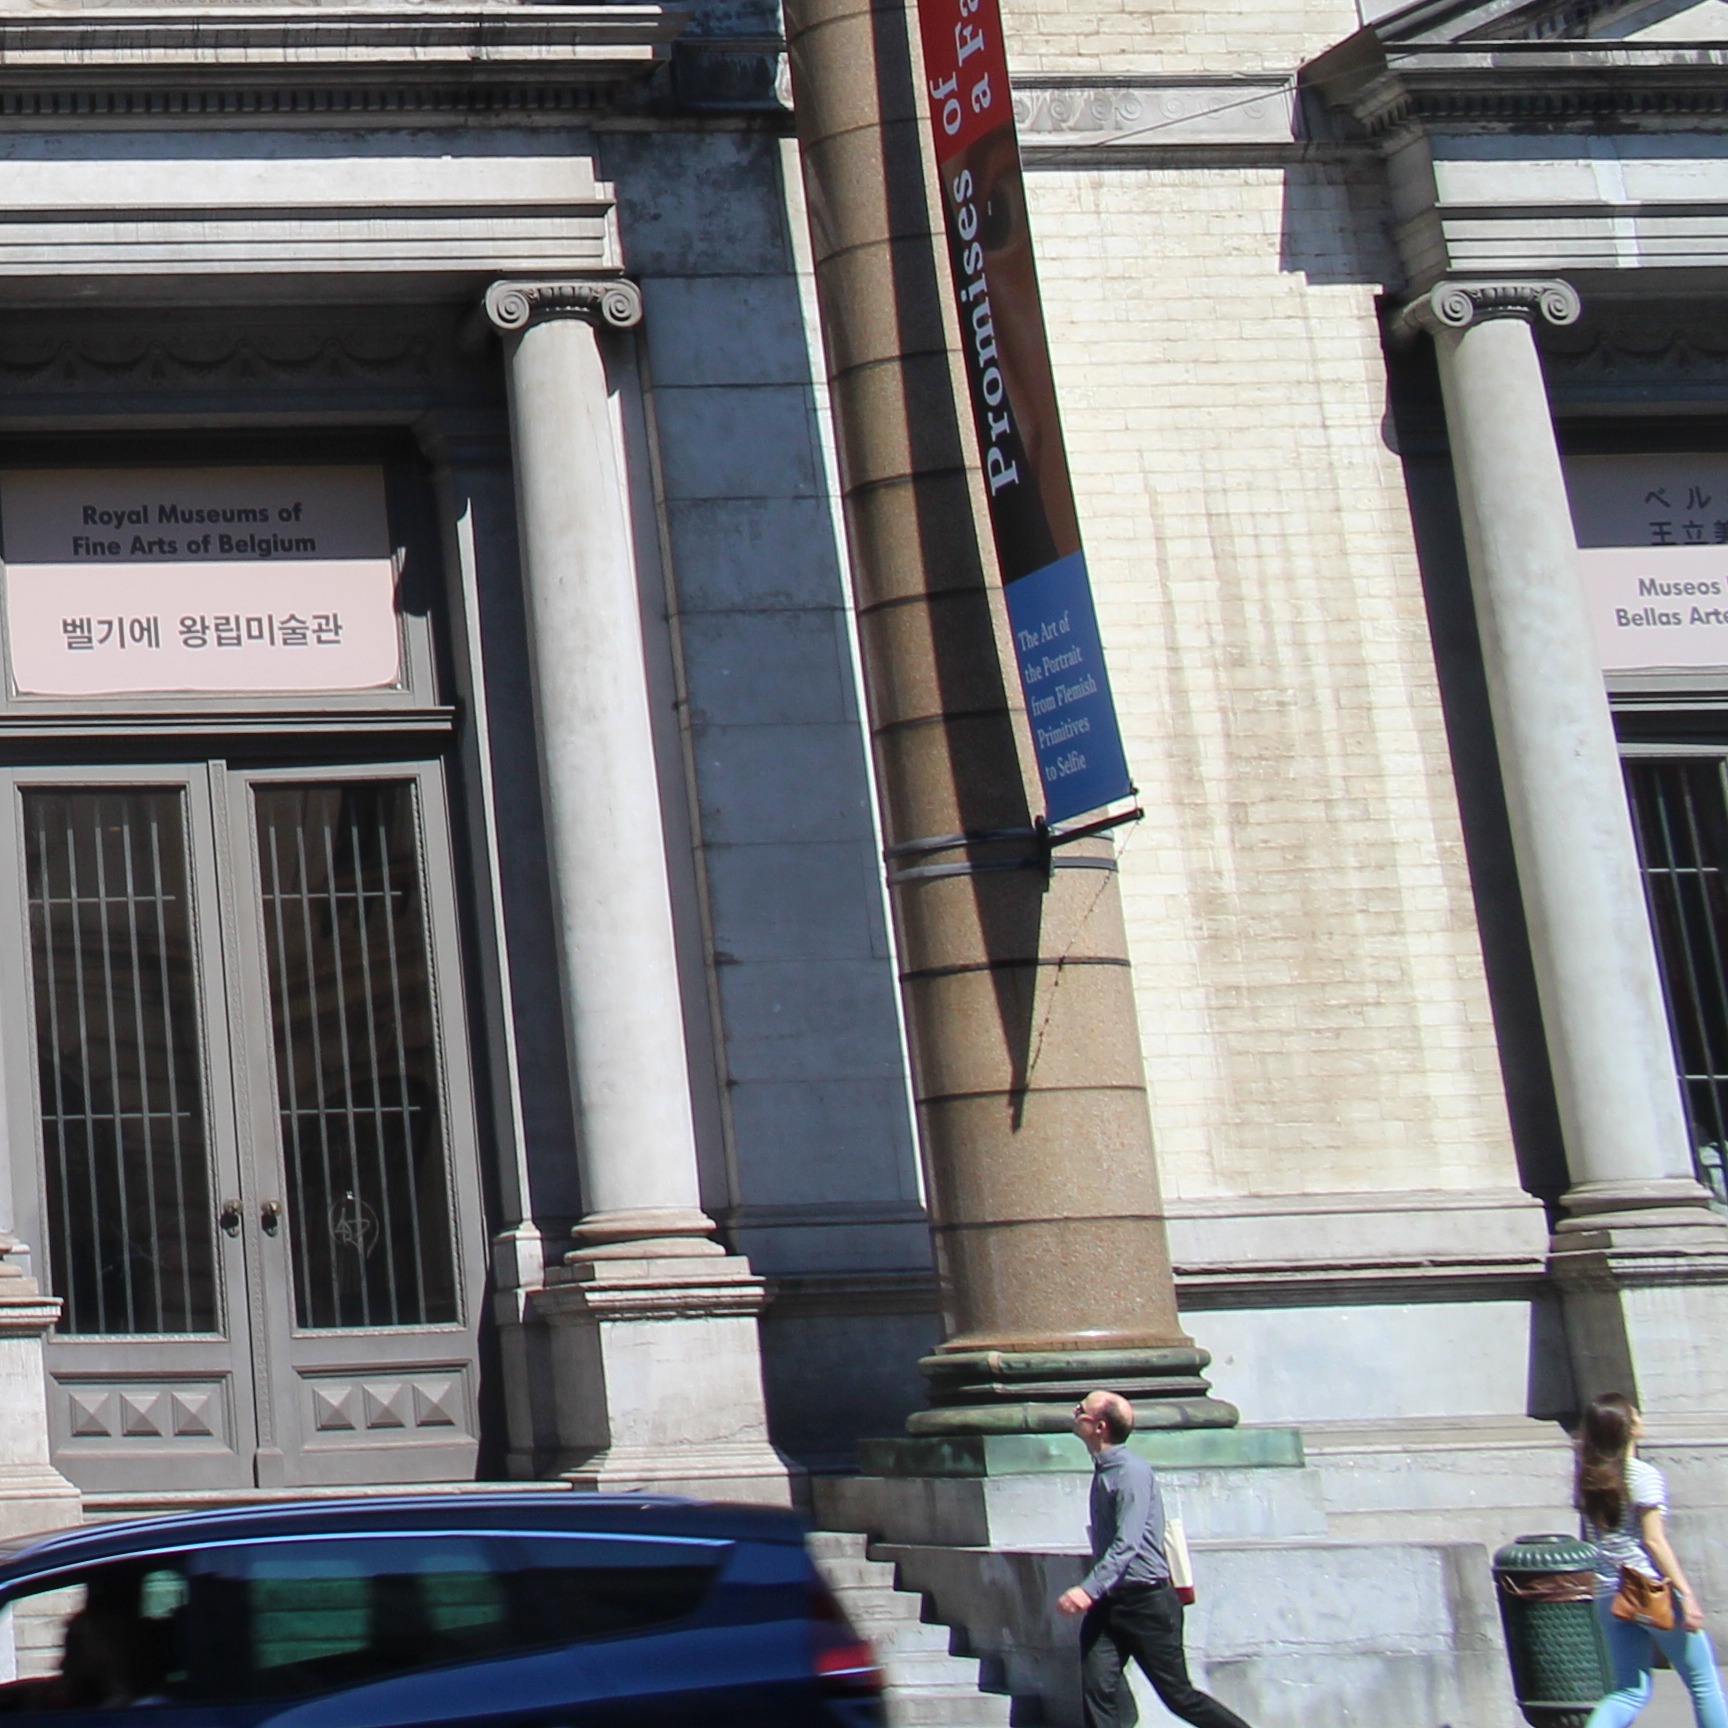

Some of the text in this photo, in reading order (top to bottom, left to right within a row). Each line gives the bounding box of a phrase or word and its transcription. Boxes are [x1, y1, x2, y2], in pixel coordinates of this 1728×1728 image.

[970, 77, 992, 114] a
[929, 70, 1019, 496] Promises of
[82, 502, 302, 530] Royal Museums of
[73, 532, 316, 558] Fine Arts of Belgium
[1638, 577, 1722, 597] Museos
[62, 613, 344, 651] 벨기에 왕립미술관
[1018, 610, 1071, 652] The Art of
[1615, 607, 1682, 627] Bellas
[1025, 645, 1084, 684] the Portrait
[1031, 673, 1098, 716] from Flemish
[1037, 716, 1090, 749] Primitives
[1045, 750, 1087, 782] to Selfie
